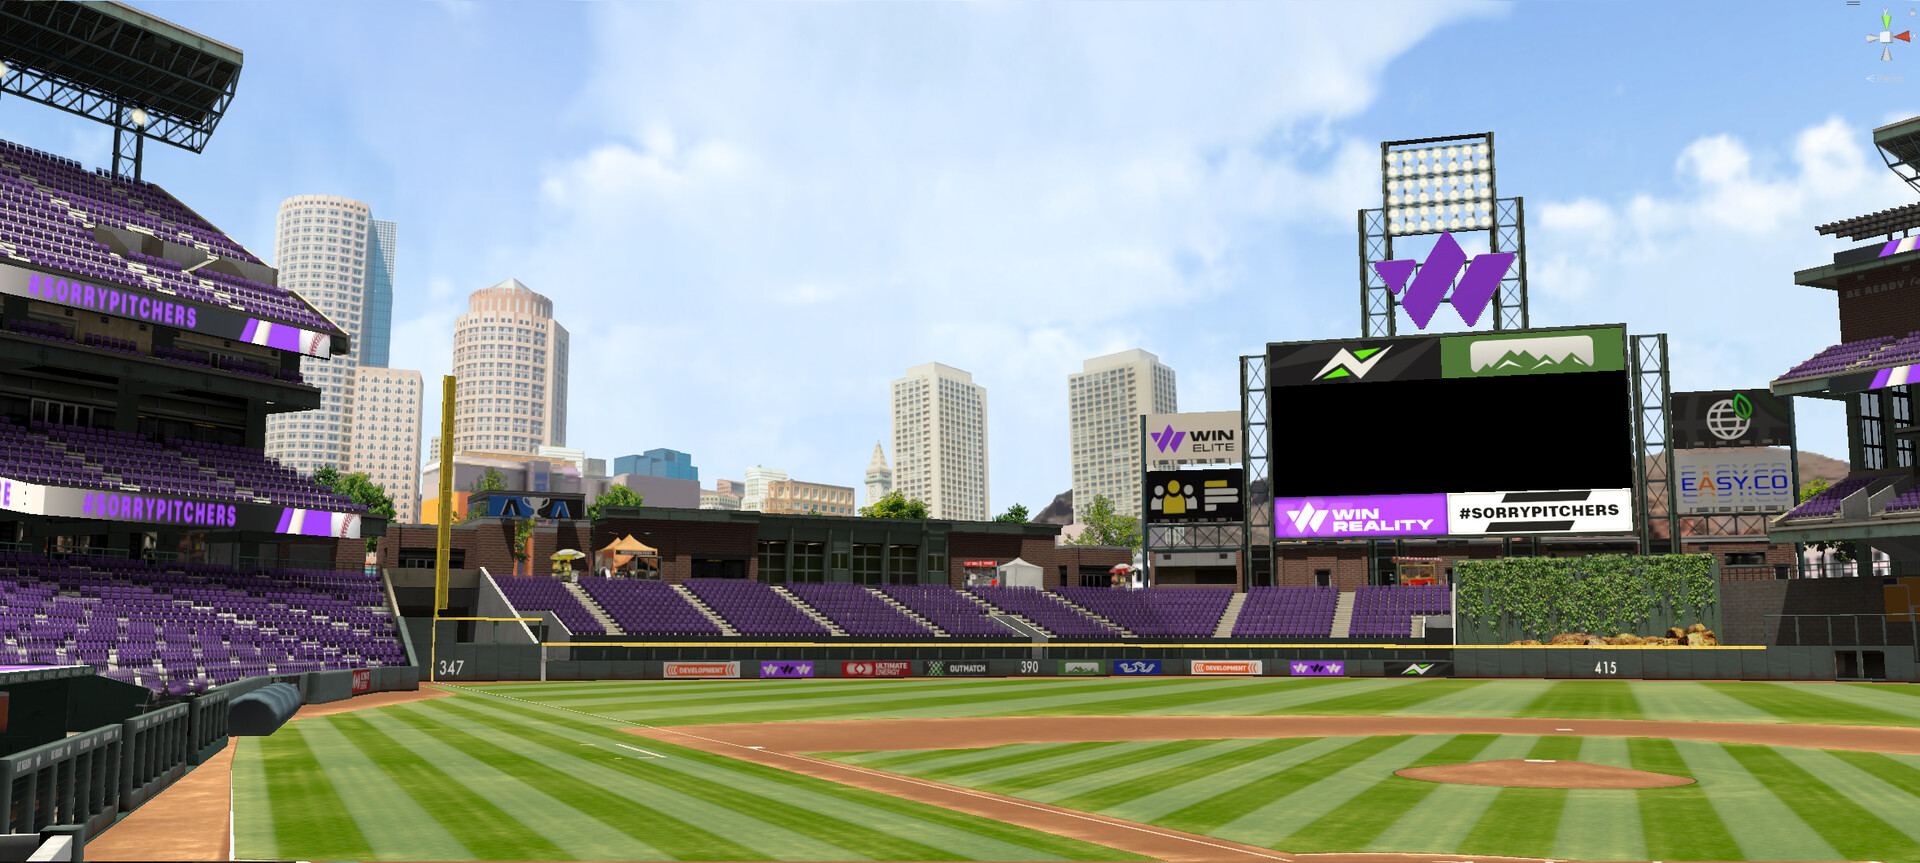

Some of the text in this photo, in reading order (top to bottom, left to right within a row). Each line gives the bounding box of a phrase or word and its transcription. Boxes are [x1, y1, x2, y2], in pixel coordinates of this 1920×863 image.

[1846, 288, 1862, 299] BE
[1864, 279, 1905, 296] READY
[28, 273, 197, 328] #SORRYPITCHERS
[1189, 429, 1234, 442] WIN
[1192, 442, 1235, 453] ELITE
[1681, 475, 1788, 491] EASY.CO
[83, 491, 237, 528] #SORRYPITCHERS
[1332, 508, 1379, 520] WIN
[1459, 504, 1620, 520] #SORRYPITCHERS
[1333, 519, 1434, 532] REALITY
[440, 660, 465, 675] 347
[679, 666, 724, 674] DEVELOPMENT
[875, 668, 900, 676] ENERGY
[949, 664, 986, 673] OUTMATCH
[1021, 660, 1039, 673] 390
[1595, 661, 1617, 674] 415
